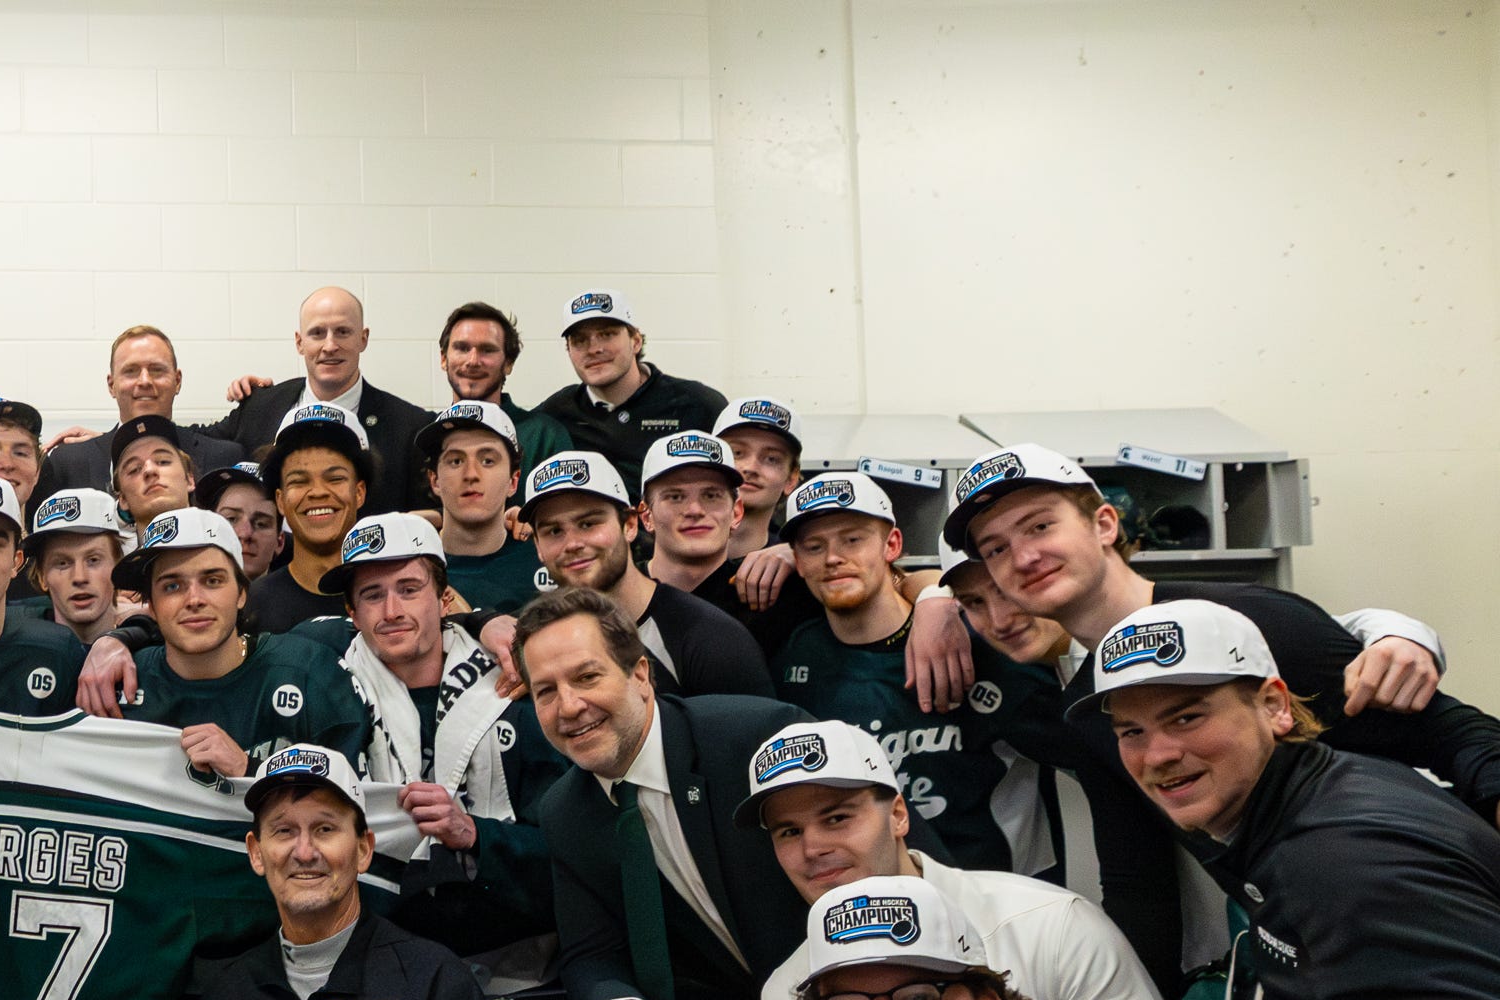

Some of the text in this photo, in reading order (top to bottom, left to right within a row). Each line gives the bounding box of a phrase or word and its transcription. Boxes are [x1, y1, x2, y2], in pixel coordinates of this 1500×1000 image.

[536, 464, 586, 482] CHAMPIONS
[914, 469, 922, 481] 9
[1175, 459, 1187, 473] 11
[958, 456, 1017, 499] CHAMPIONS
[799, 485, 850, 505] CHAMPIONS
[1103, 631, 1177, 663] CHAMPIONS
[31, 673, 53, 692] DS
[277, 691, 300, 710] DS
[971, 684, 999, 708] DS
[269, 755, 327, 771] CHAMPIONS
[756, 741, 819, 775] CHAMPIONS
[828, 907, 913, 935] CHAMPIONS
